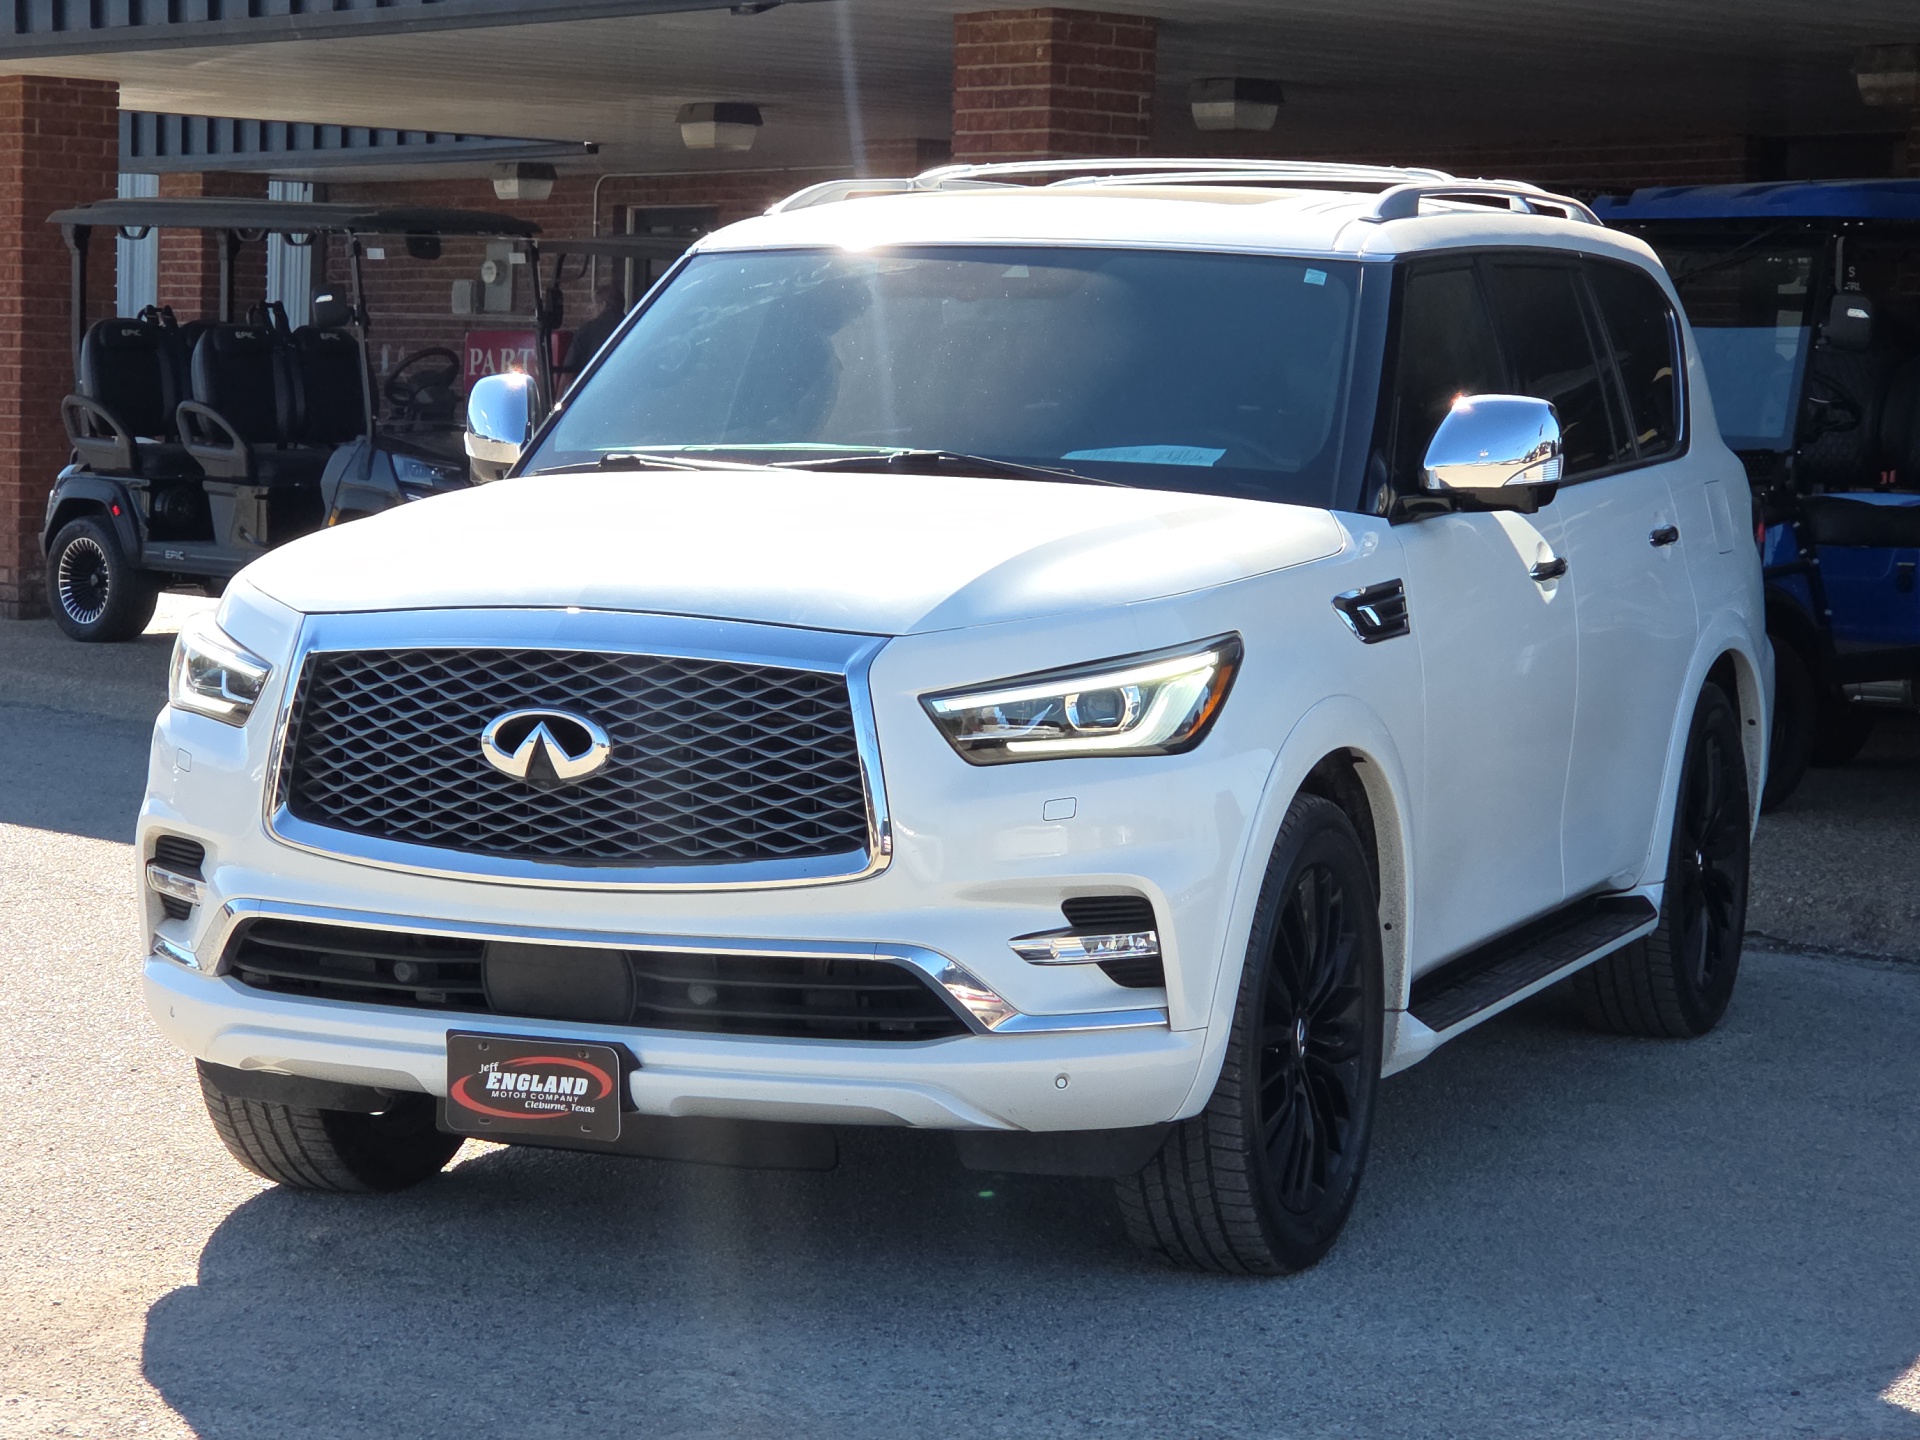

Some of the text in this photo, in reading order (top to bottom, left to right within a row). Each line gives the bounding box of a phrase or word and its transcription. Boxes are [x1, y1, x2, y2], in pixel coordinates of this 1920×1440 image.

[468, 347, 539, 376] PART
[164, 549, 185, 561] EPIC
[478, 1062, 500, 1074] Jeff
[485, 1072, 588, 1095] ENGLAND
[491, 1090, 579, 1103] MOTOR COMPANY
[571, 1103, 596, 1114] Texas
